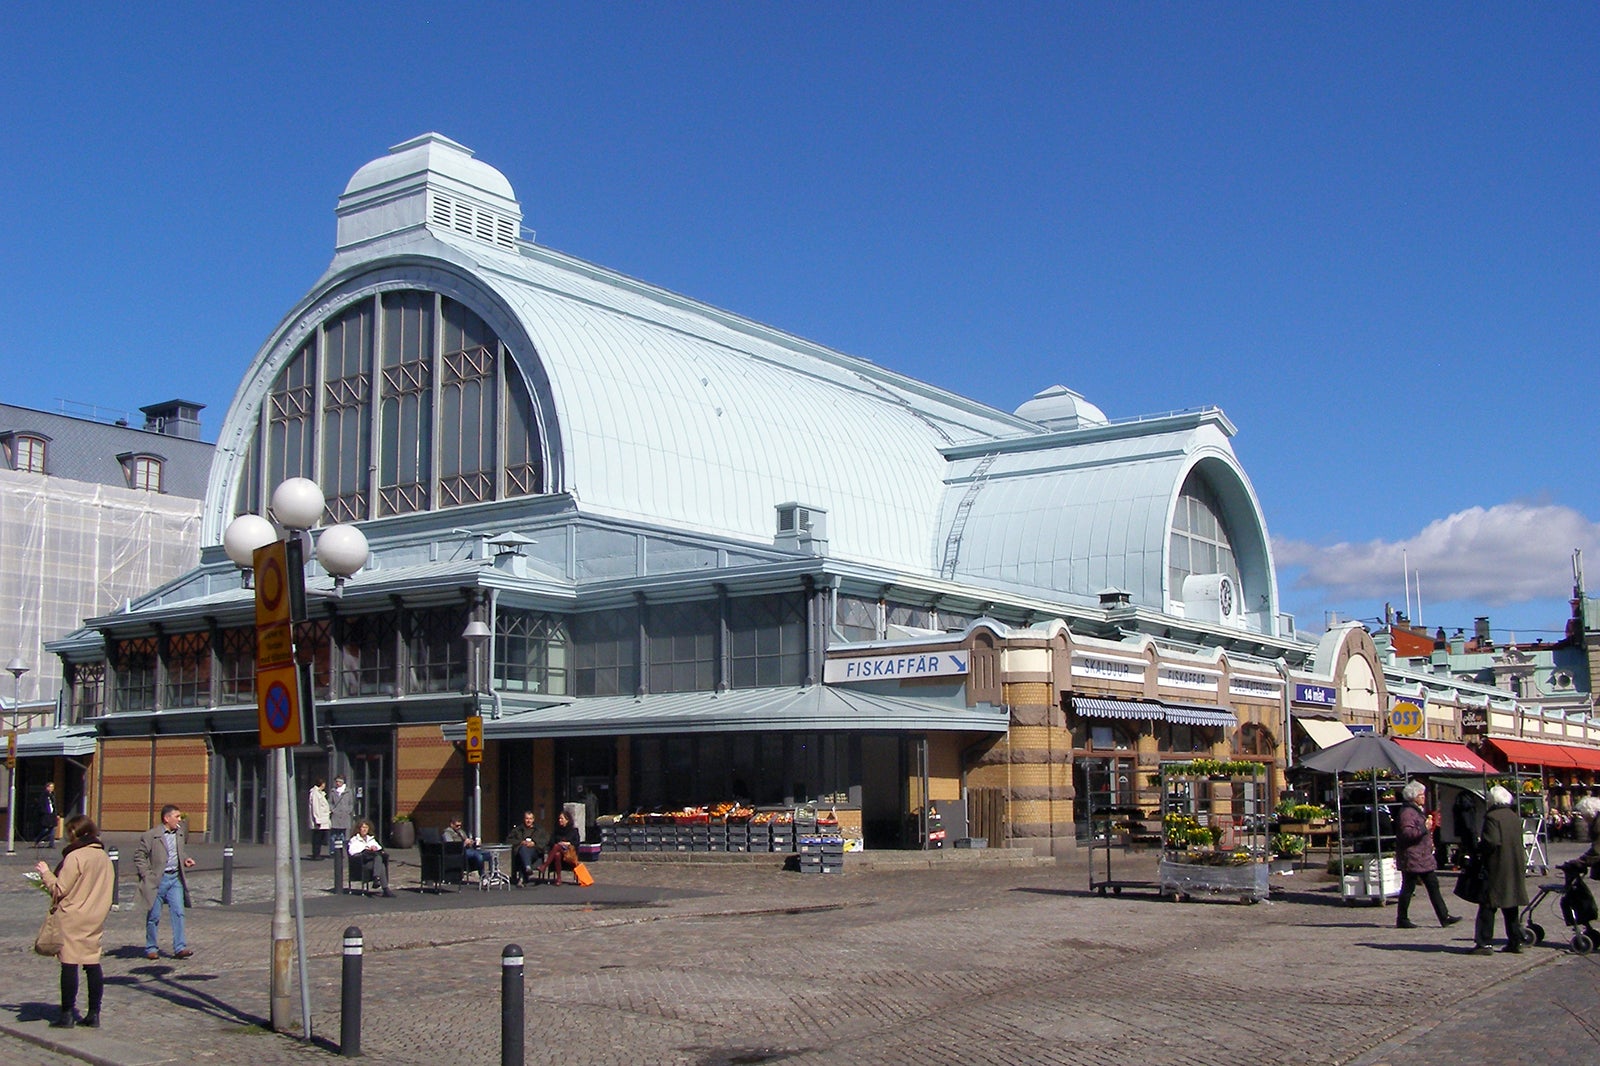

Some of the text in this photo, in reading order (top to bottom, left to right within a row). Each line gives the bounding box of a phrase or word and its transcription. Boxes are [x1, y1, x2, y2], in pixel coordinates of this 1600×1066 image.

[846, 655, 939, 678] FISKAFFÄR
[1085, 659, 1130, 678] SKALDJUR
[1393, 711, 1419, 726] OST
